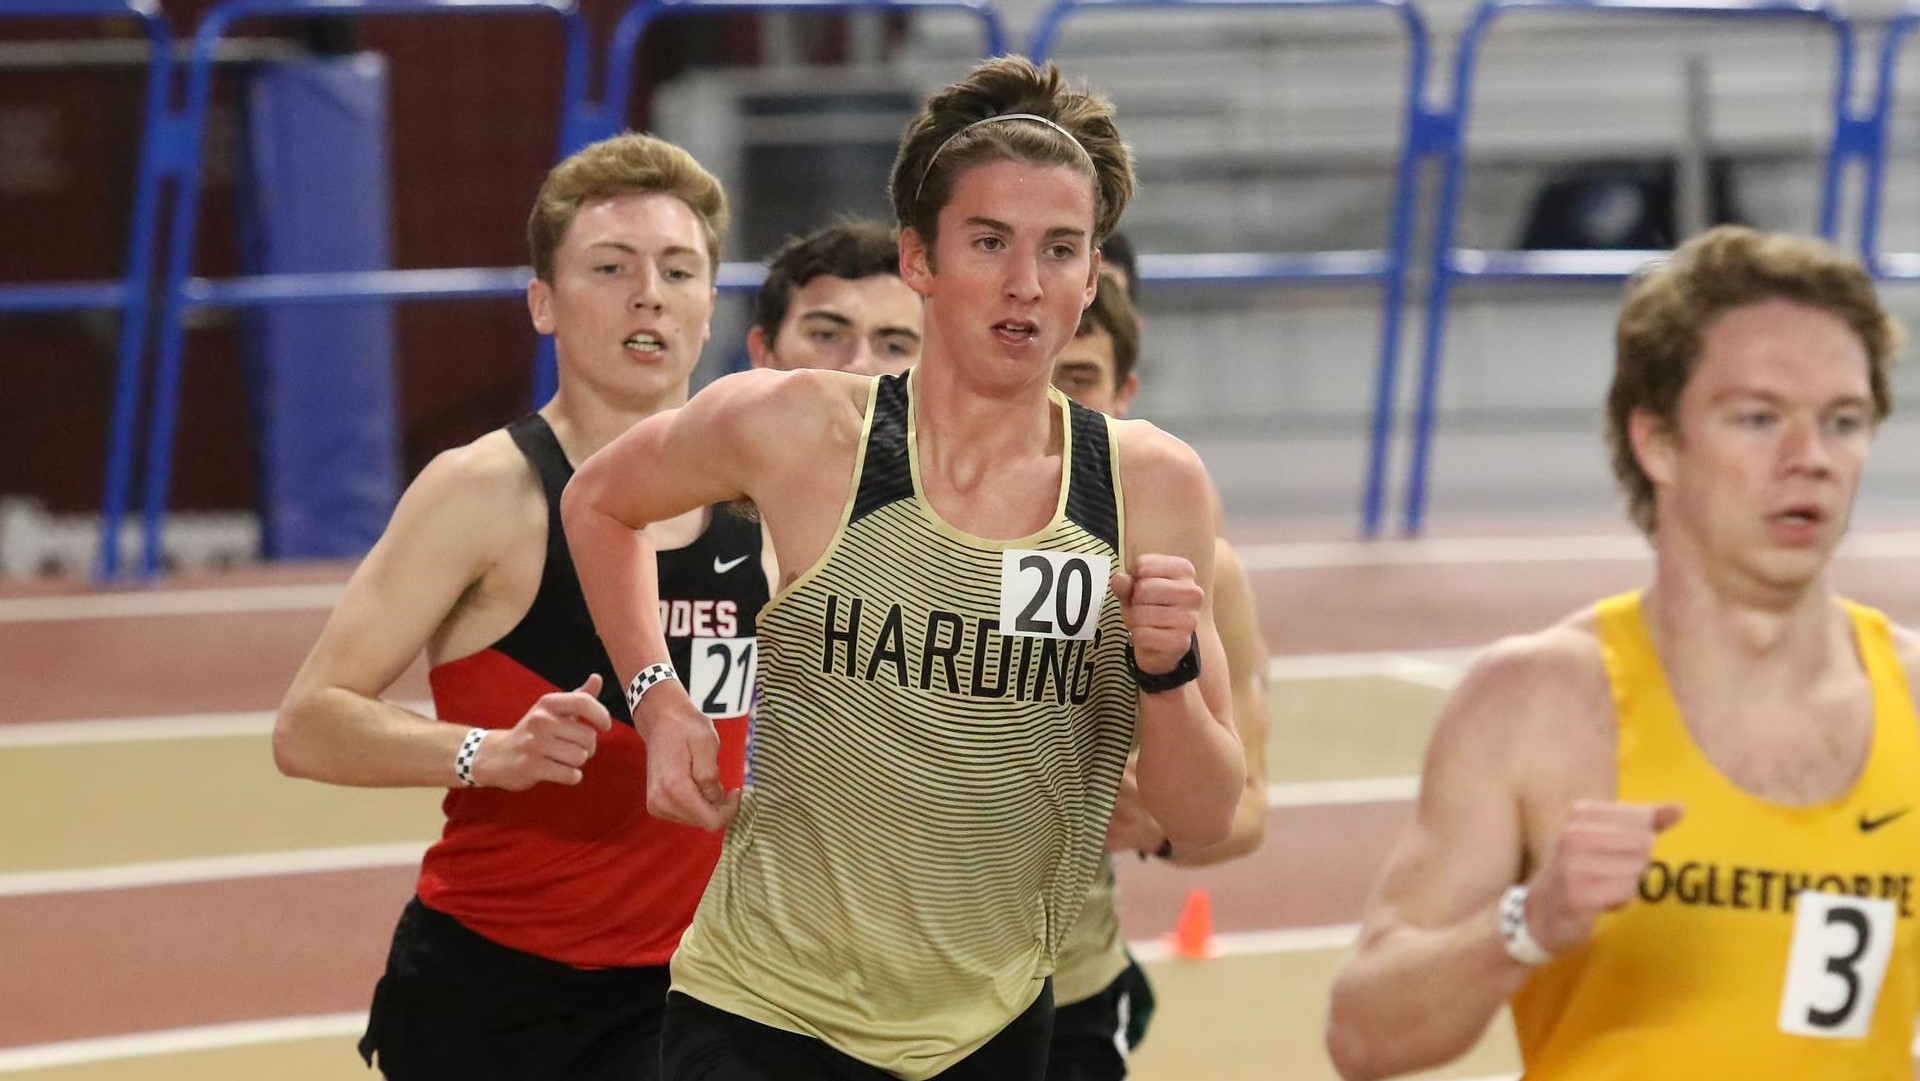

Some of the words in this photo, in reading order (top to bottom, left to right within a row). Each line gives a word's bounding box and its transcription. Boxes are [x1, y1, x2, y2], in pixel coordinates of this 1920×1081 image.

[1015, 554, 1093, 637] 20
[703, 643, 752, 713] 21
[823, 594, 1102, 705] HARDING
[1807, 908, 1870, 1028] 3
